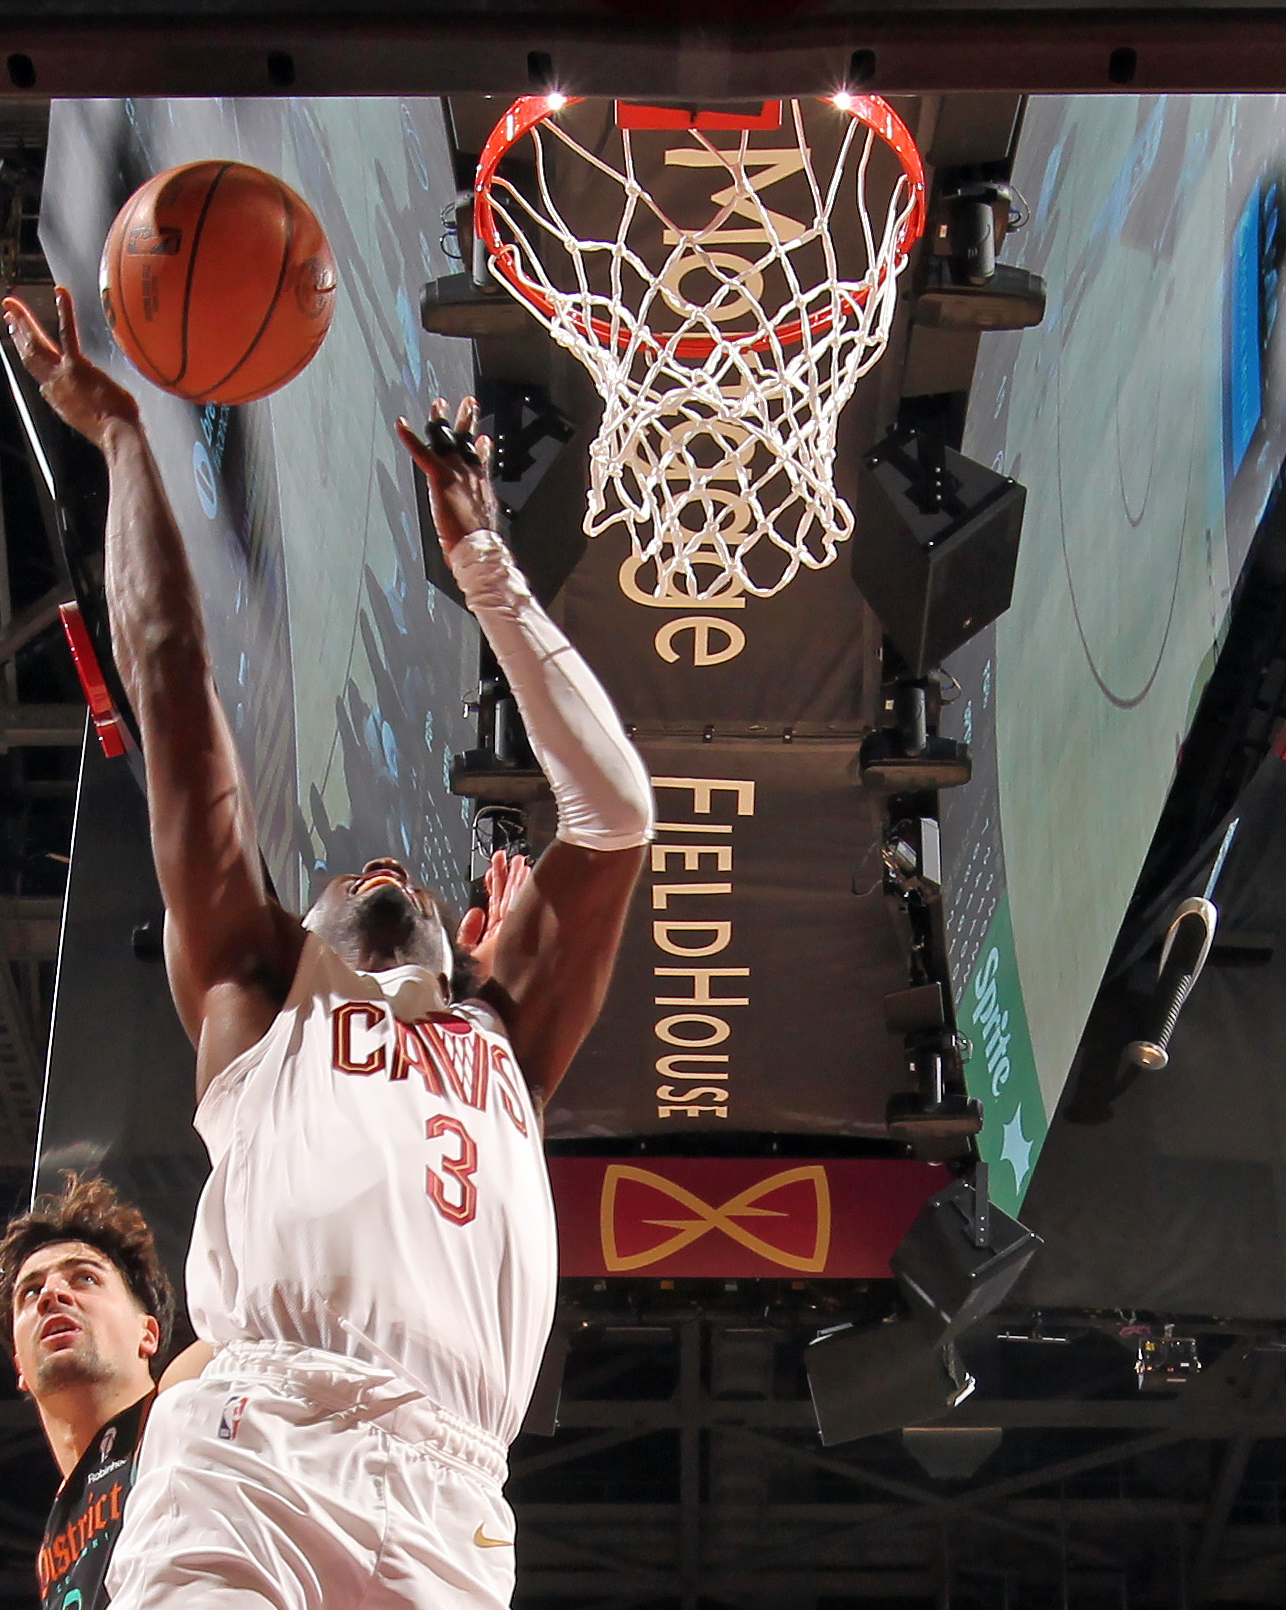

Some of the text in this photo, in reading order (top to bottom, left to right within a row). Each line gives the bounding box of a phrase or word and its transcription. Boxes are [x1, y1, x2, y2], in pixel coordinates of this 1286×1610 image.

[332, 1002, 529, 1139] CAVS
[973, 947, 1011, 1097] Sprite
[426, 1113, 478, 1227] 3
[36, 1482, 123, 1601] istrict
